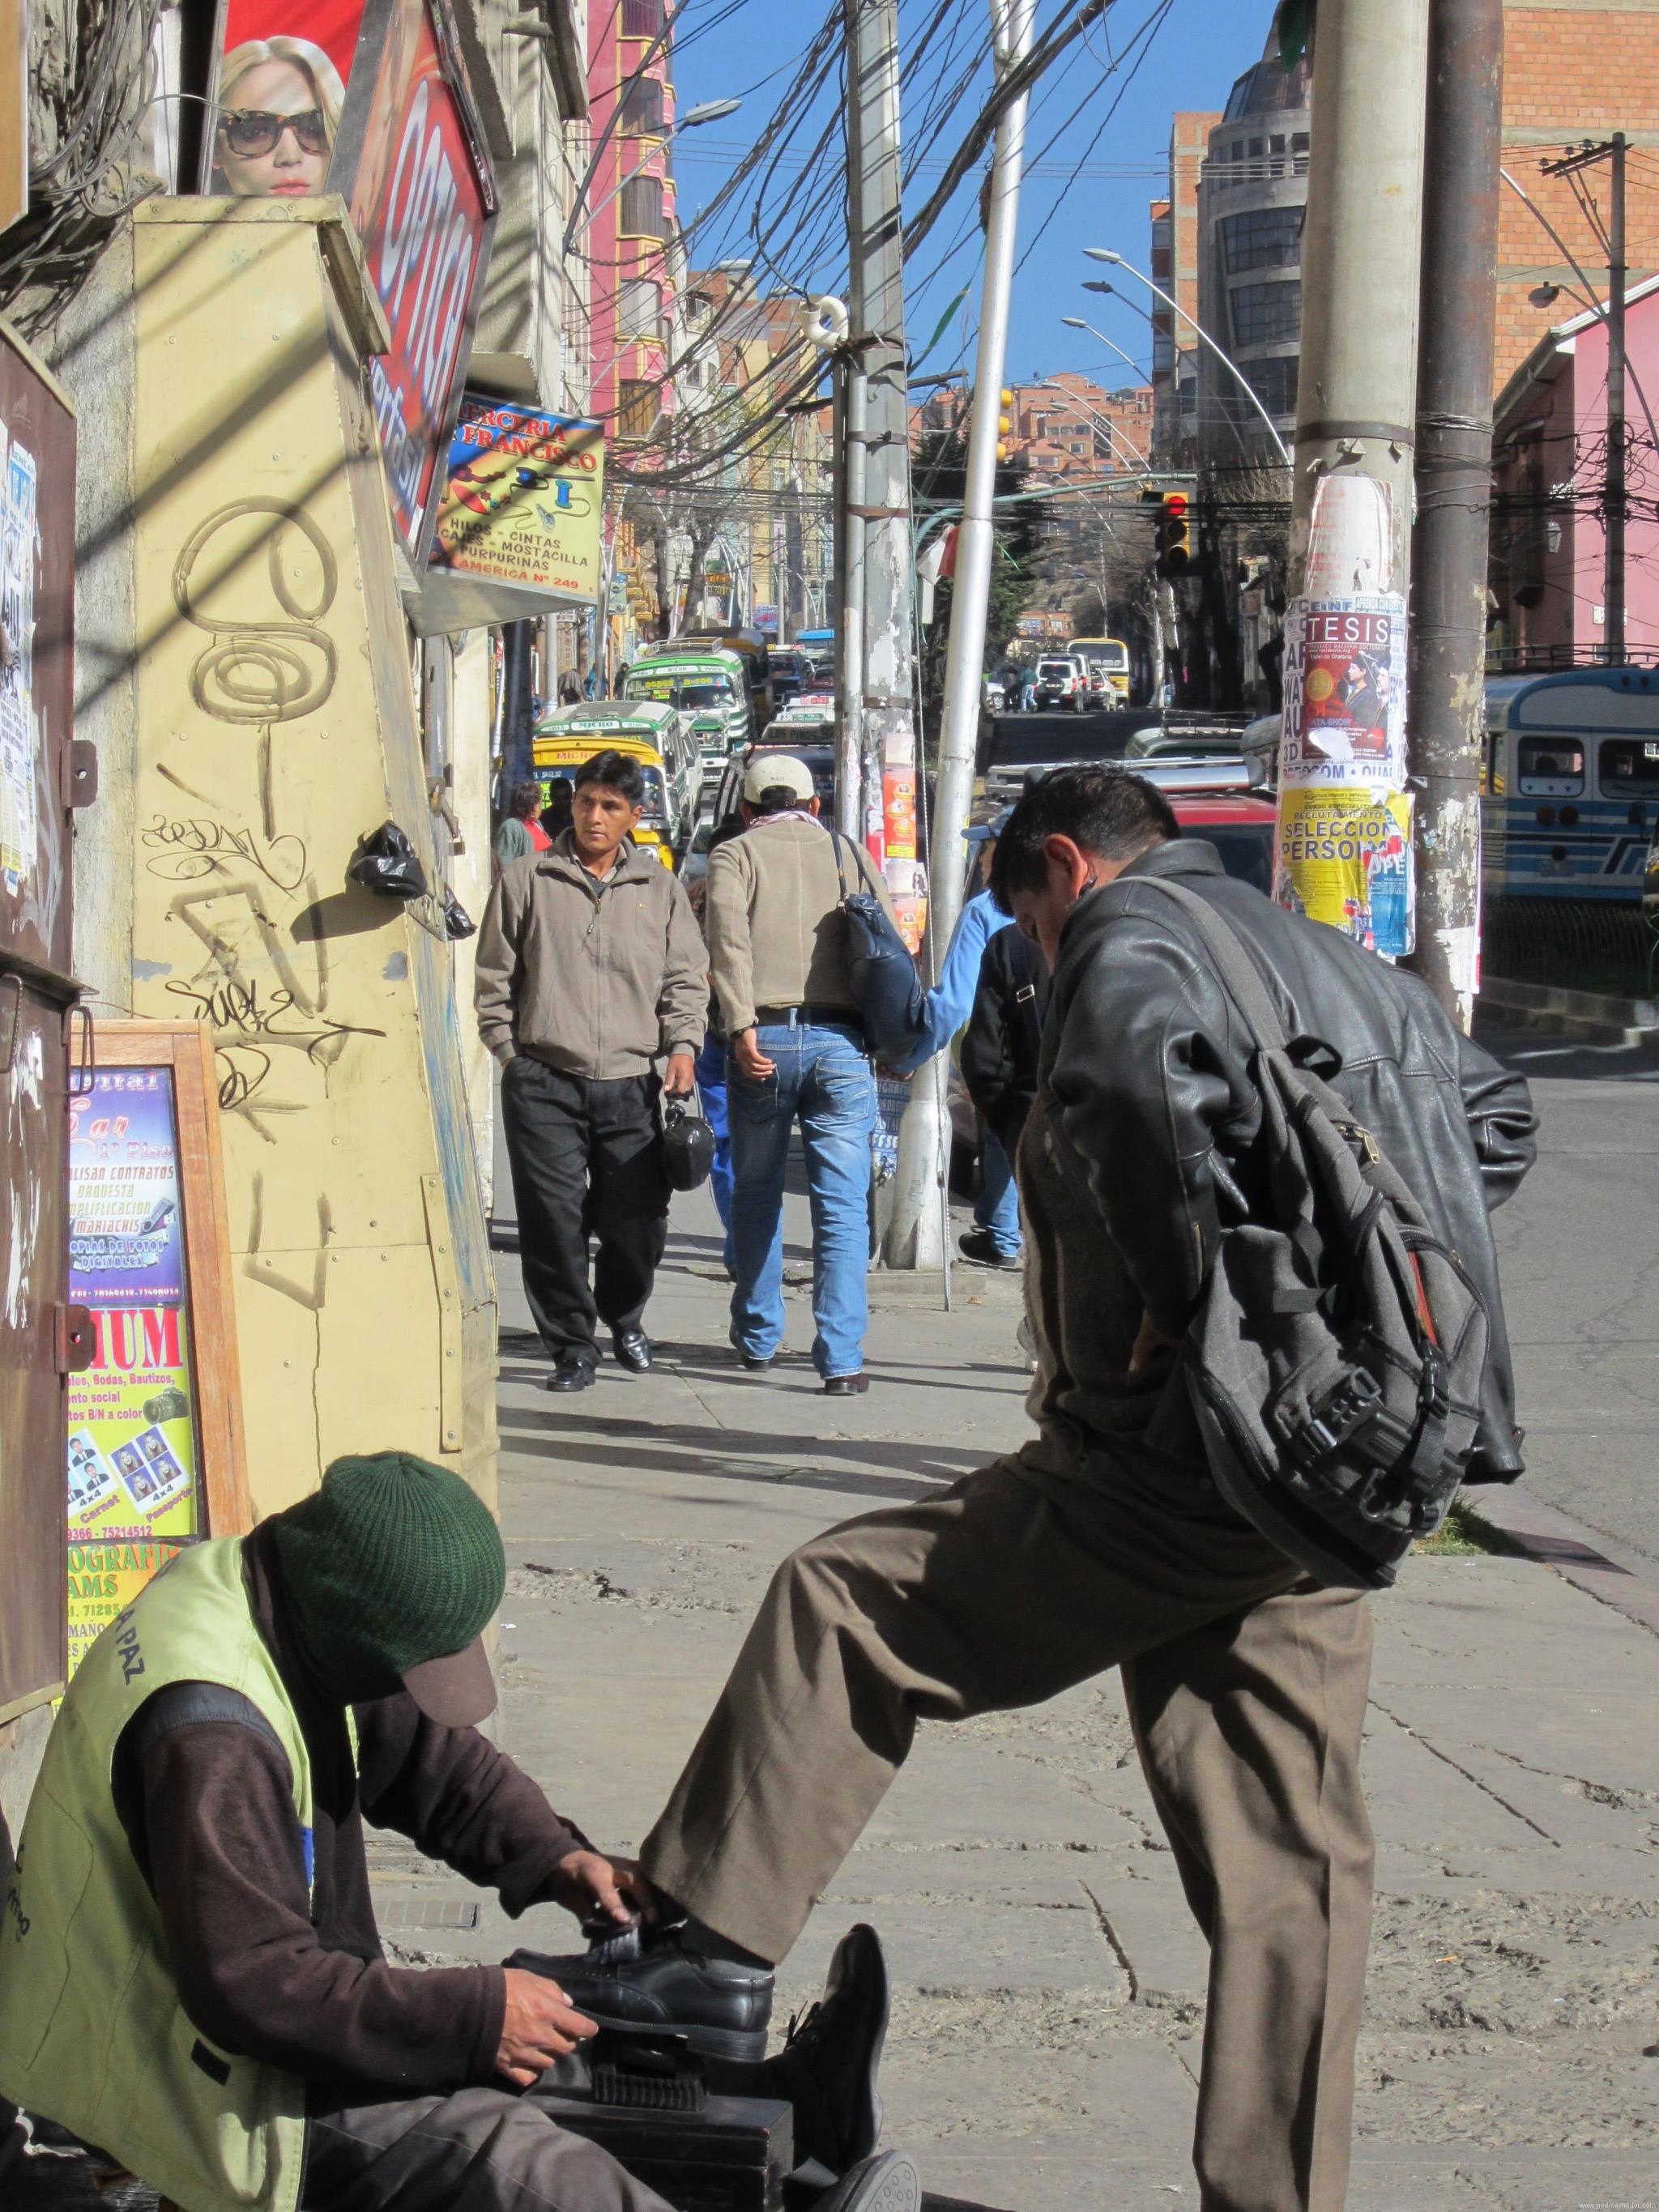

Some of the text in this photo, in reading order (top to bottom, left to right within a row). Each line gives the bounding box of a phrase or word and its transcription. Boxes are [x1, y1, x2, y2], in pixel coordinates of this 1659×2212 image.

[458, 402, 567, 444] ERCERIA
[463, 424, 598, 472] FRANCISCO
[450, 518, 561, 549] HILOS CINTAS
[436, 528, 589, 567] CAJES MOSTACILLA
[460, 544, 550, 571] PURPURINAS
[458, 560, 528, 580] AMERICA
[554, 578, 579, 589] 249
[1307, 617, 1388, 643] TESIS
[70, 1238, 105, 1254] OPIAS
[128, 1238, 164, 1253] FOTOS
[93, 1374, 126, 1387] Bodas,
[130, 1373, 175, 1385] Bautizos,
[91, 1391, 121, 1403] social
[108, 1411, 114, 1420] a
[117, 1408, 143, 1420] color
[79, 1489, 102, 1507] 4x4
[152, 1484, 174, 1502] 4x4
[79, 1494, 121, 1524] Carnet
[116, 1626, 145, 1686] PAZ
